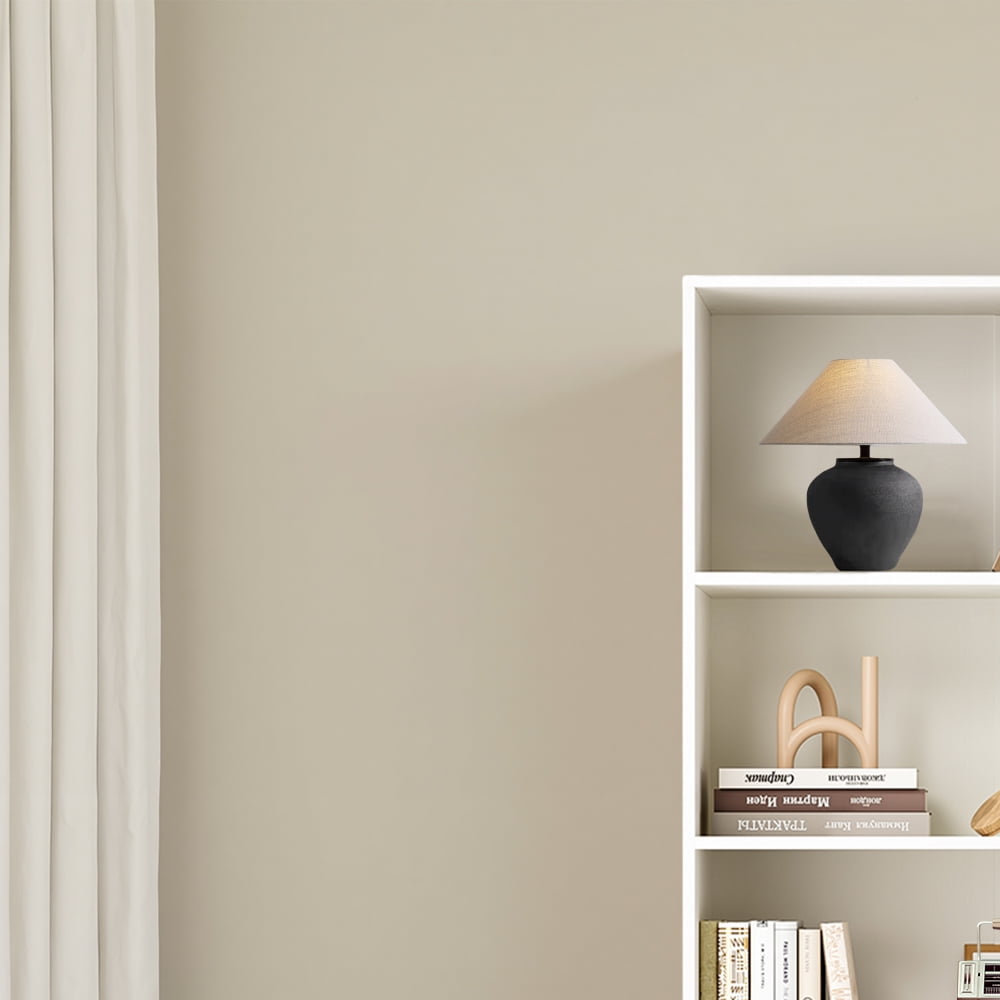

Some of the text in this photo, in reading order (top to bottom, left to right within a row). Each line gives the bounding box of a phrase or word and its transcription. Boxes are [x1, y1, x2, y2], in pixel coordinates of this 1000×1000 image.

[745, 771, 795, 785] Спартак
[746, 794, 830, 807] Мартин Иден
[738, 820, 807, 831] ТРАКТАТЫ
